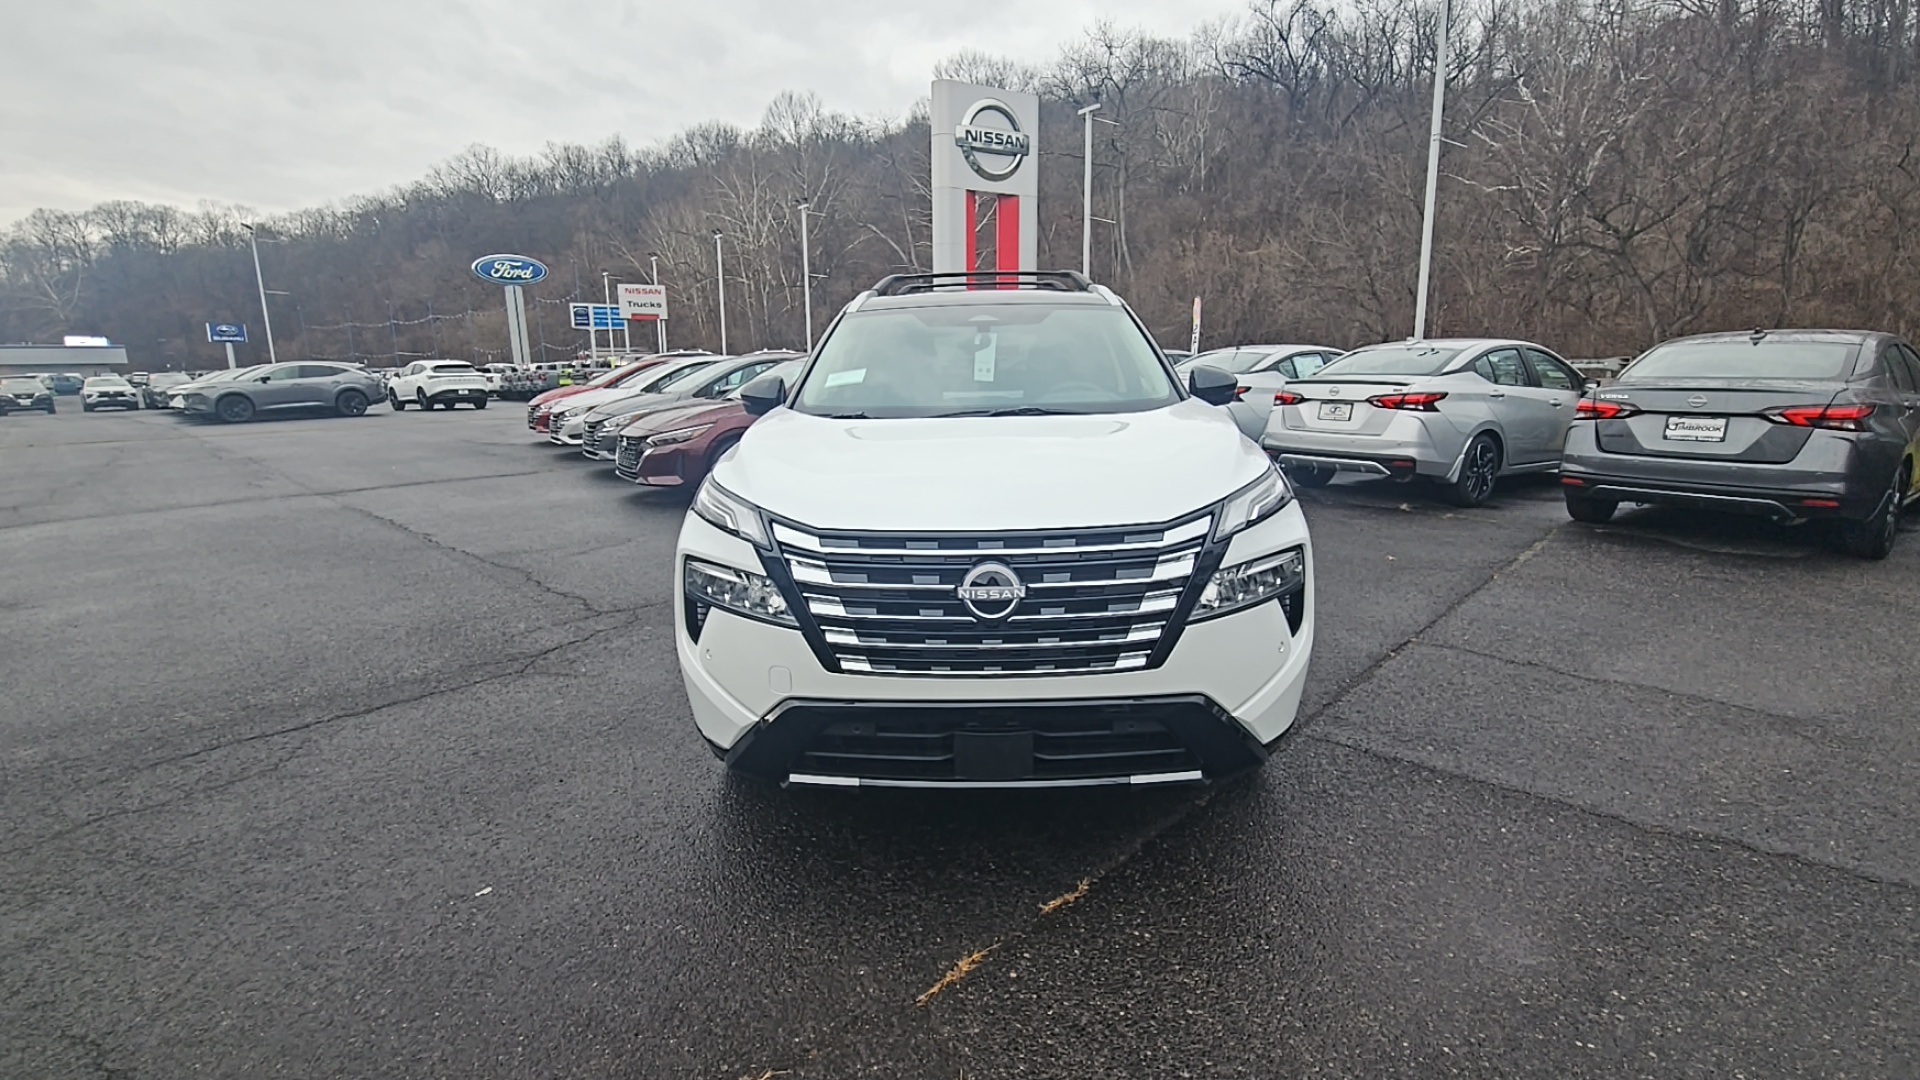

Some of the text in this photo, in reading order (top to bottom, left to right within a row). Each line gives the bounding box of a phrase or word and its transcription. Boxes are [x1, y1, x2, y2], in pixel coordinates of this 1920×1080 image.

[965, 129, 1025, 149] NISSAN
[490, 260, 534, 279] Ford
[624, 287, 662, 295] NISSAN
[627, 300, 663, 309] Trucks
[959, 589, 1026, 599] NISSAN
